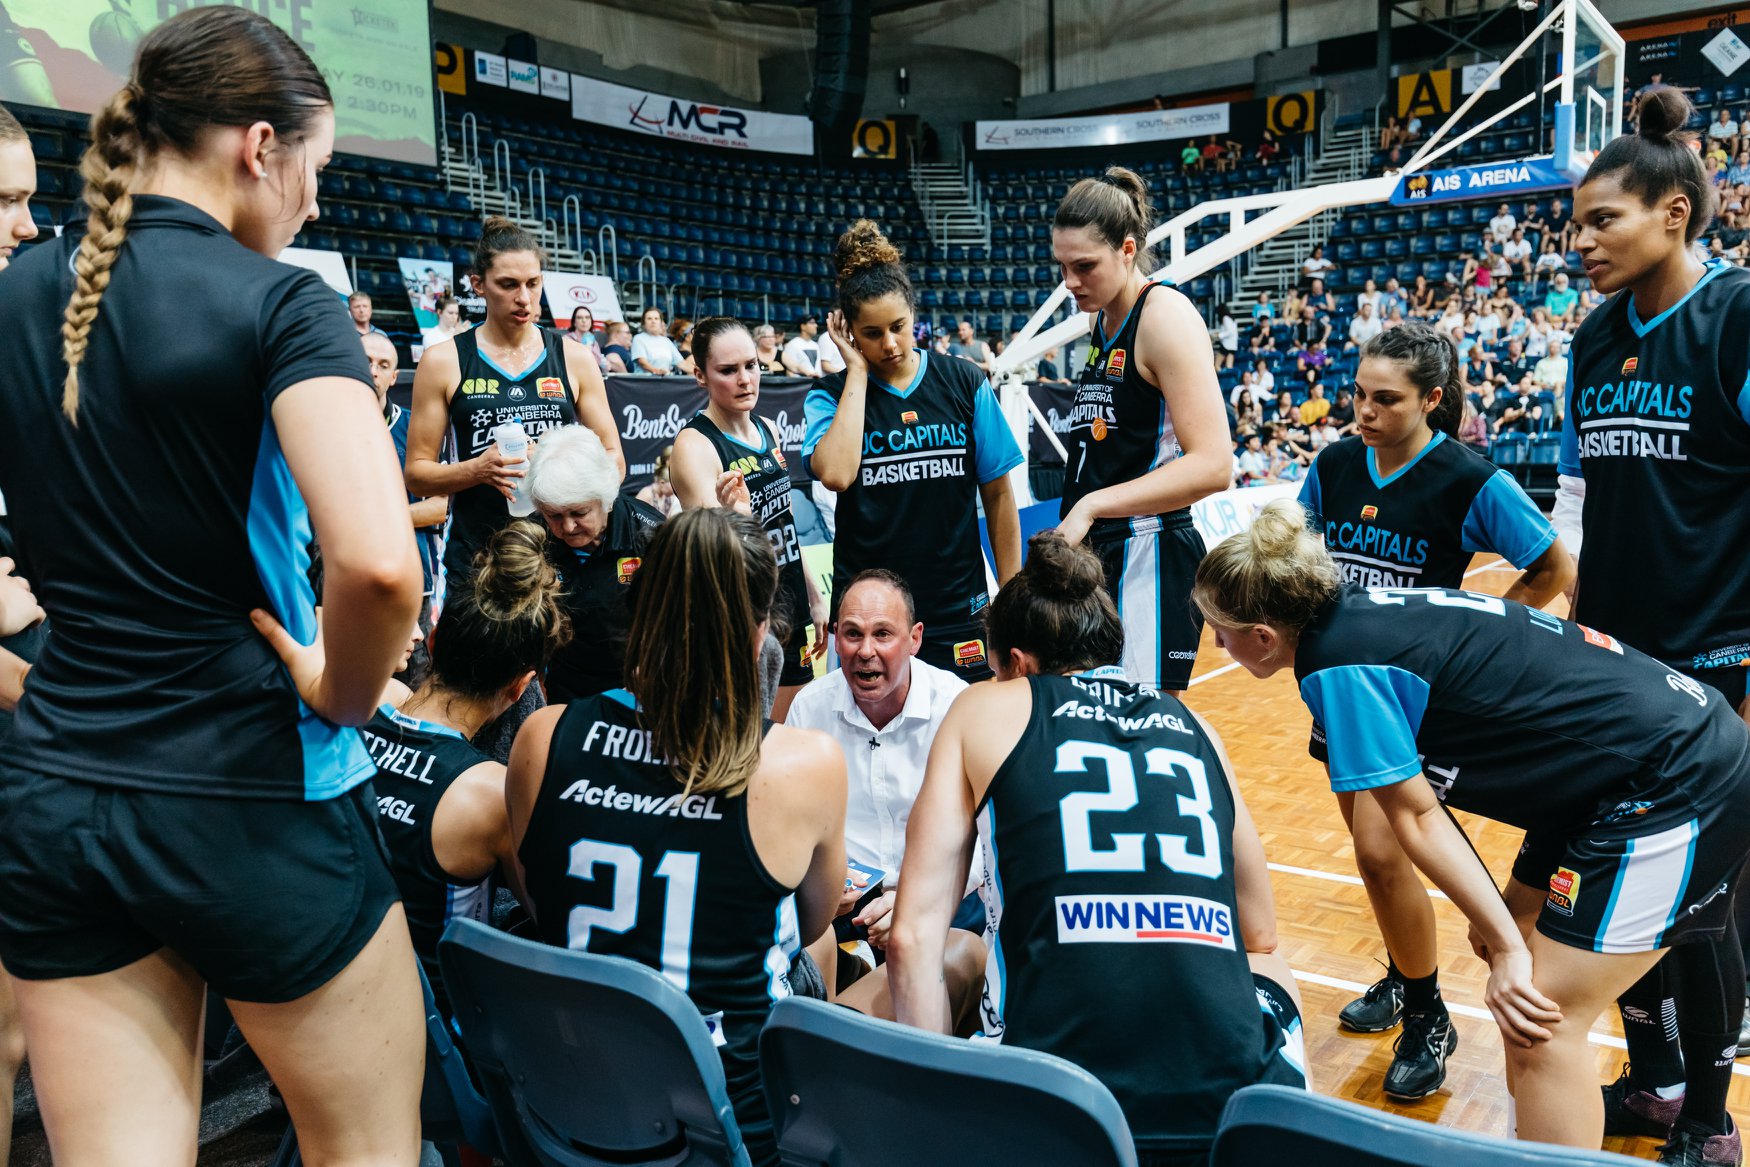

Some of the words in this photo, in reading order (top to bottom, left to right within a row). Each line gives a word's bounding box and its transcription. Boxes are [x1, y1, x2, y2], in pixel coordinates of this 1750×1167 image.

[1707, 13, 1737, 29] exit
[1405, 72, 1445, 117] A
[667, 100, 749, 139] MCR
[1189, 112, 1221, 124] CROSS
[1272, 93, 1309, 135] Q
[856, 120, 892, 157] Q
[1014, 126, 1065, 137] SOUTHERN
[1432, 174, 1462, 193] AIS
[1468, 166, 1531, 188] ARENA
[496, 405, 549, 415] UNIVERSITY
[1079, 392, 1113, 404] CANBERRA
[496, 410, 562, 424] CANBERRA
[888, 423, 967, 451] CAPITALS
[862, 458, 965, 486] BASKETBALL
[767, 523, 800, 567] 22
[1338, 521, 1429, 565] CAPITALS
[559, 779, 723, 820] ActewAGL
[1053, 740, 1223, 880] 23
[566, 838, 700, 992] 21
